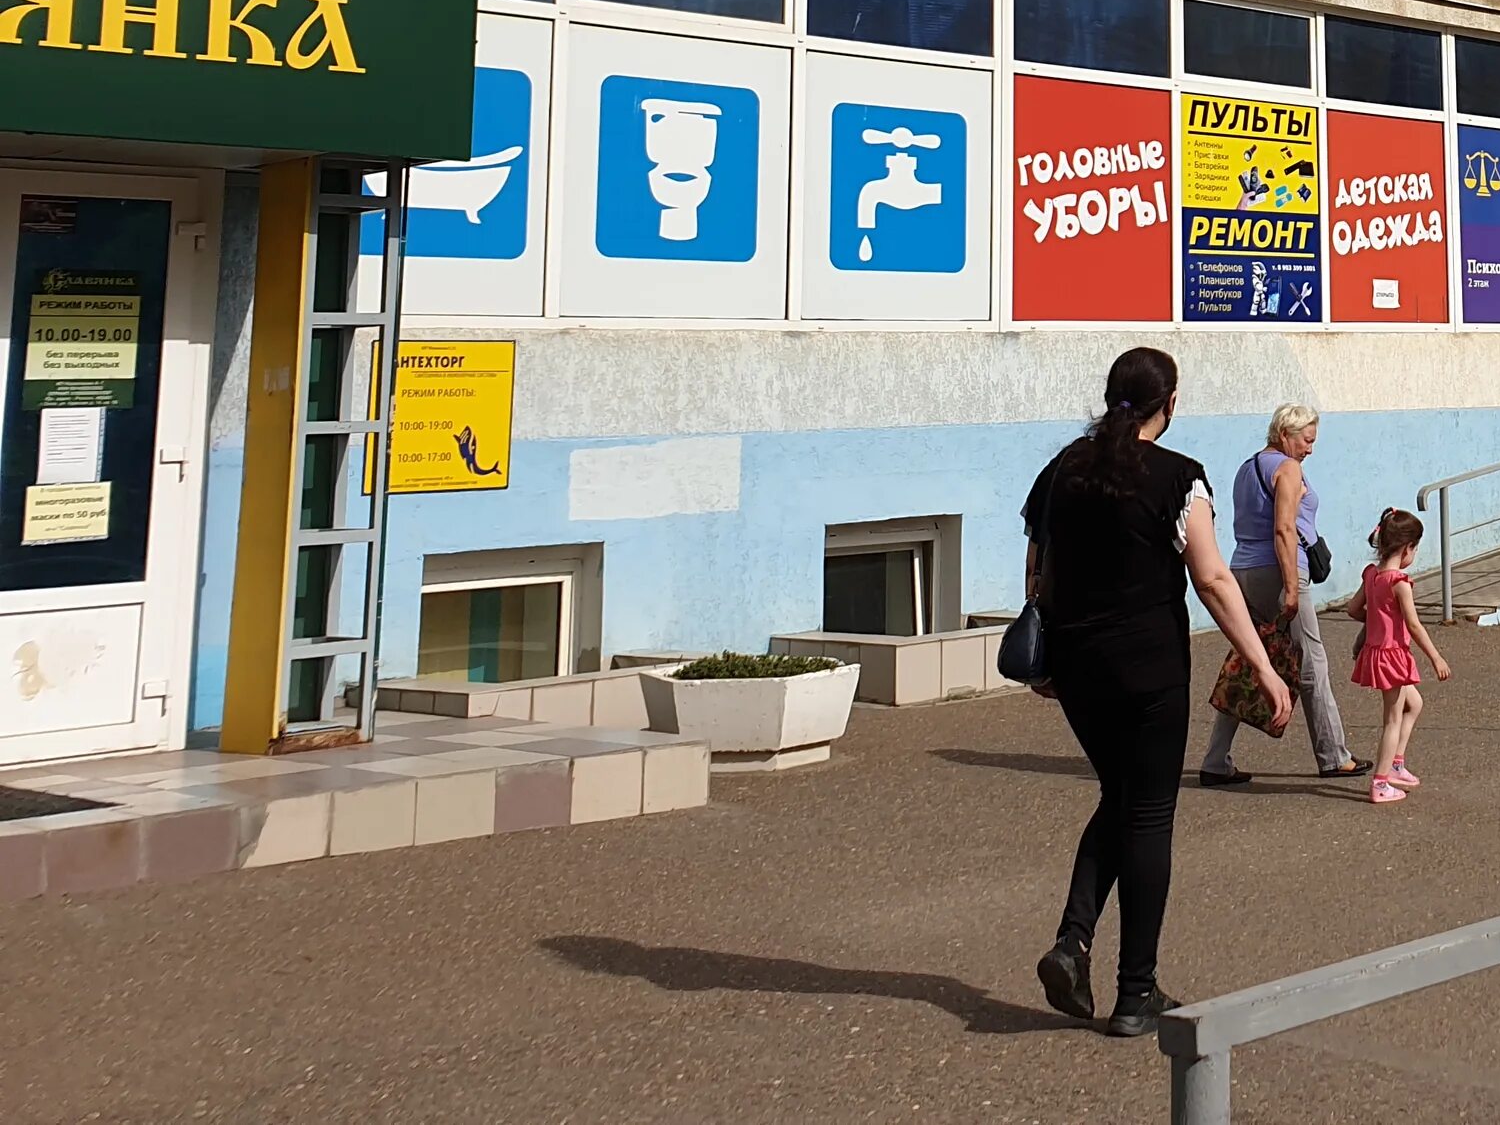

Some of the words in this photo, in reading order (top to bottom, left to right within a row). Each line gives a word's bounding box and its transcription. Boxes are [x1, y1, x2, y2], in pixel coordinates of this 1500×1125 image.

[1188, 100, 1311, 137] ПУЛЬТЫ
[1194, 151, 1229, 160] Присавки
[1189, 216, 1313, 250] РЕМОНТ
[1197, 262, 1243, 273] Телефонов
[1198, 275, 1244, 286] Планшетов
[1468, 278, 1473, 287] 2
[1474, 279, 1489, 288] этаж
[1198, 288, 1242, 300] Ноутбуков
[40, 301, 82, 309] РЕЖИМ
[84, 301, 133, 310] РАБОТЫ
[1198, 302, 1232, 313] Пультов
[35, 328, 132, 342] 10.00-19.00
[396, 356, 465, 368] НТЕХТОРГ
[402, 388, 435, 398] РЕЖИМ
[437, 388, 476, 397] РАБОТЫ:
